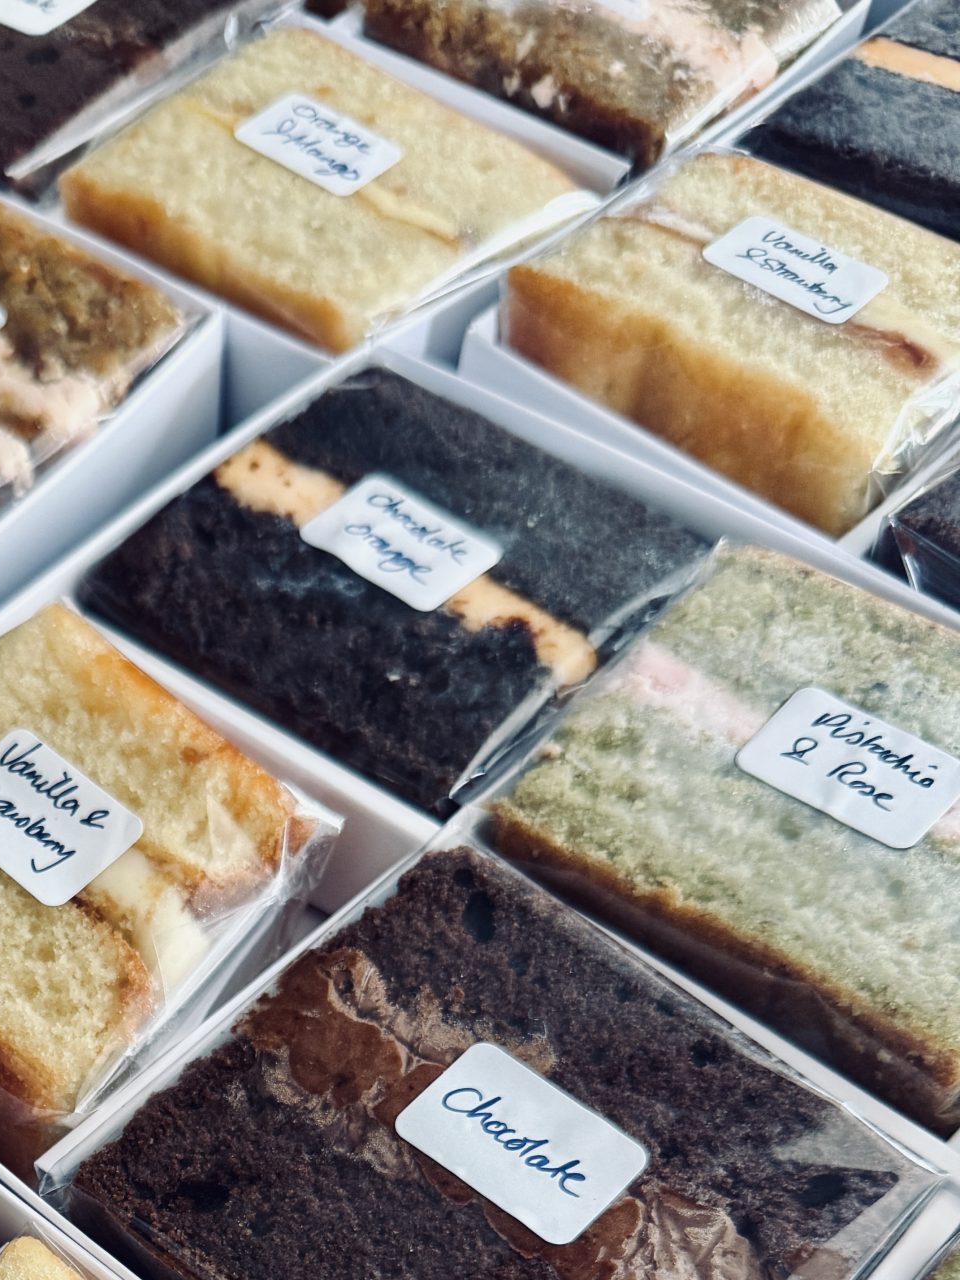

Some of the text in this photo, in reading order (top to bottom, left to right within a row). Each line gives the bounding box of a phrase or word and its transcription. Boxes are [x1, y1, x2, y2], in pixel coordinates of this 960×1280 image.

[293, 102, 371, 156] Orange
[763, 230, 838, 276] Vanilla
[0, 741, 112, 831] Vanilla &
[781, 736, 893, 813] & Rose
[814, 711, 936, 790] Pistachio
[441, 1086, 588, 1200] Chocolate
